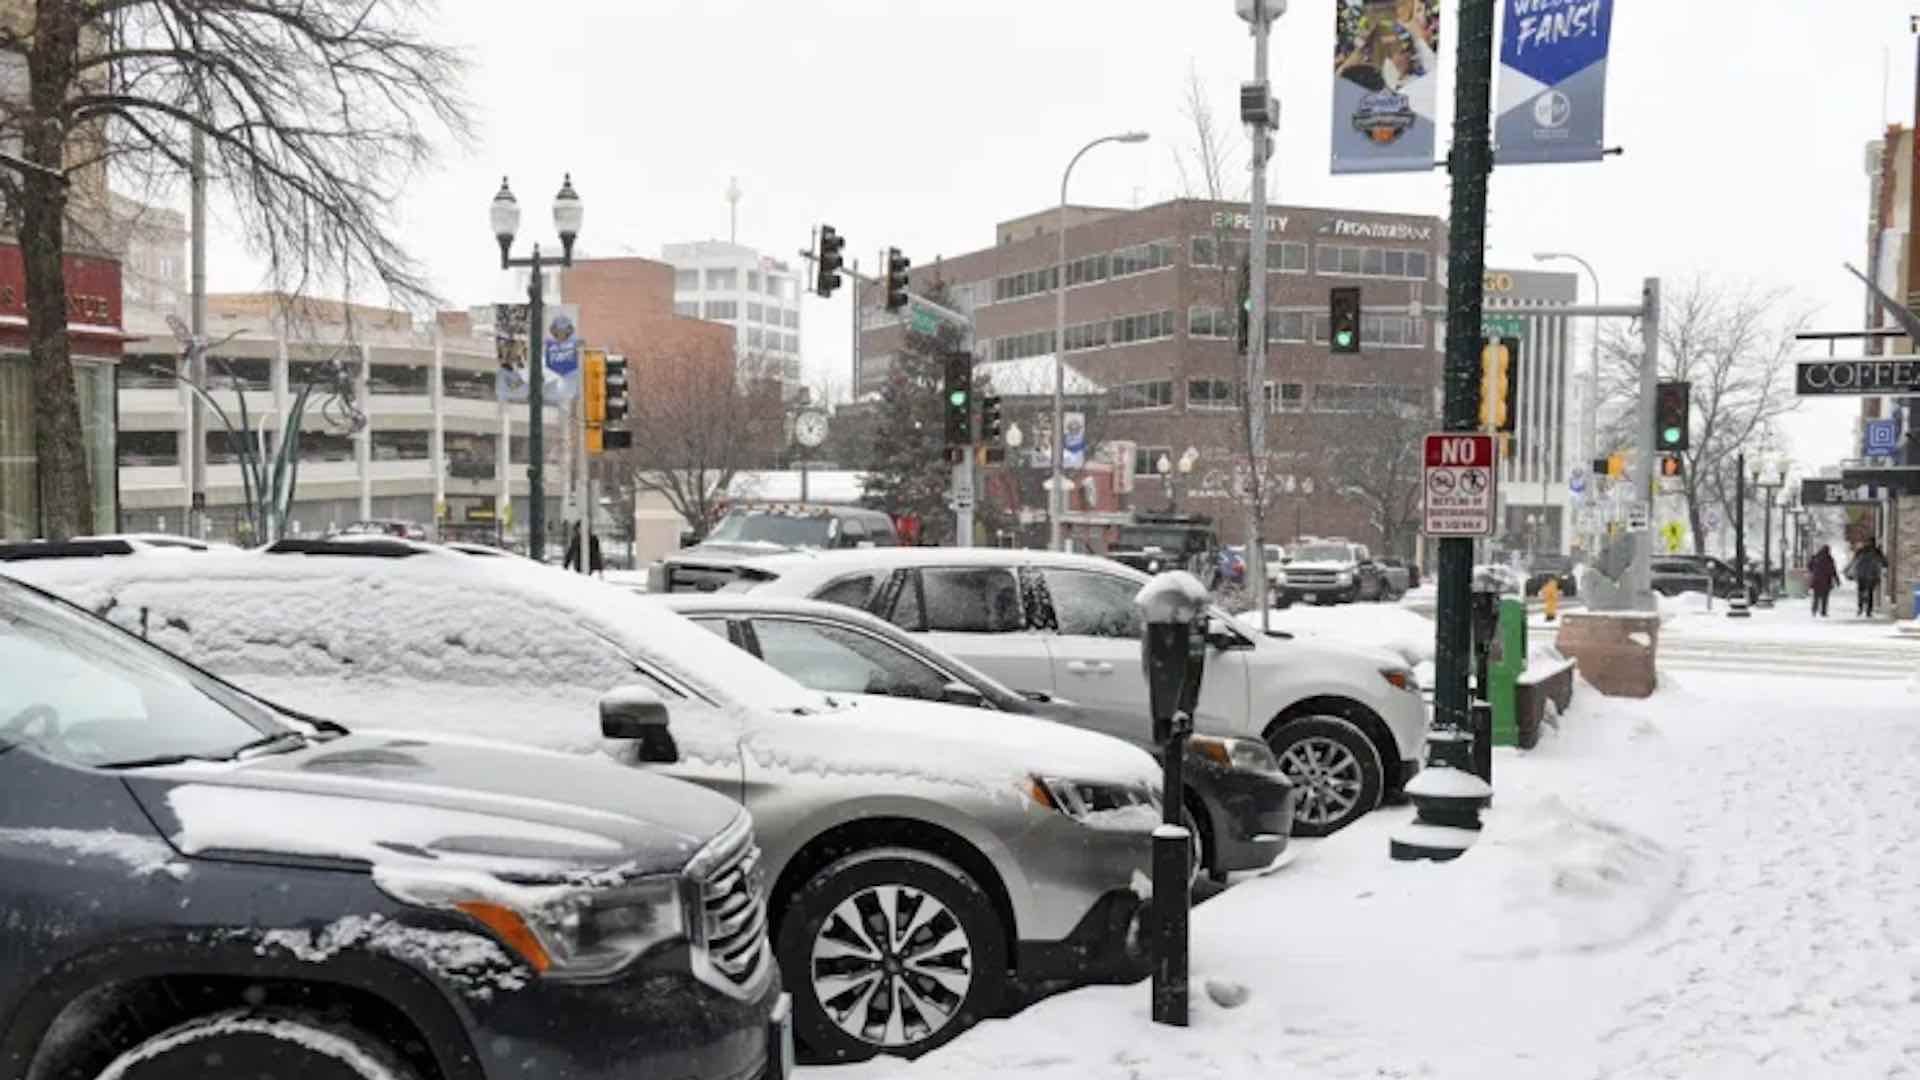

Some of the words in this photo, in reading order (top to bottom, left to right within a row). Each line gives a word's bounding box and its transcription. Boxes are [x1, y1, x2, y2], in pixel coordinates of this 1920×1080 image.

[1517, 1, 1600, 56] FANS!
[1210, 210, 1289, 233] EXPEITY
[1441, 438, 1476, 466] NO
